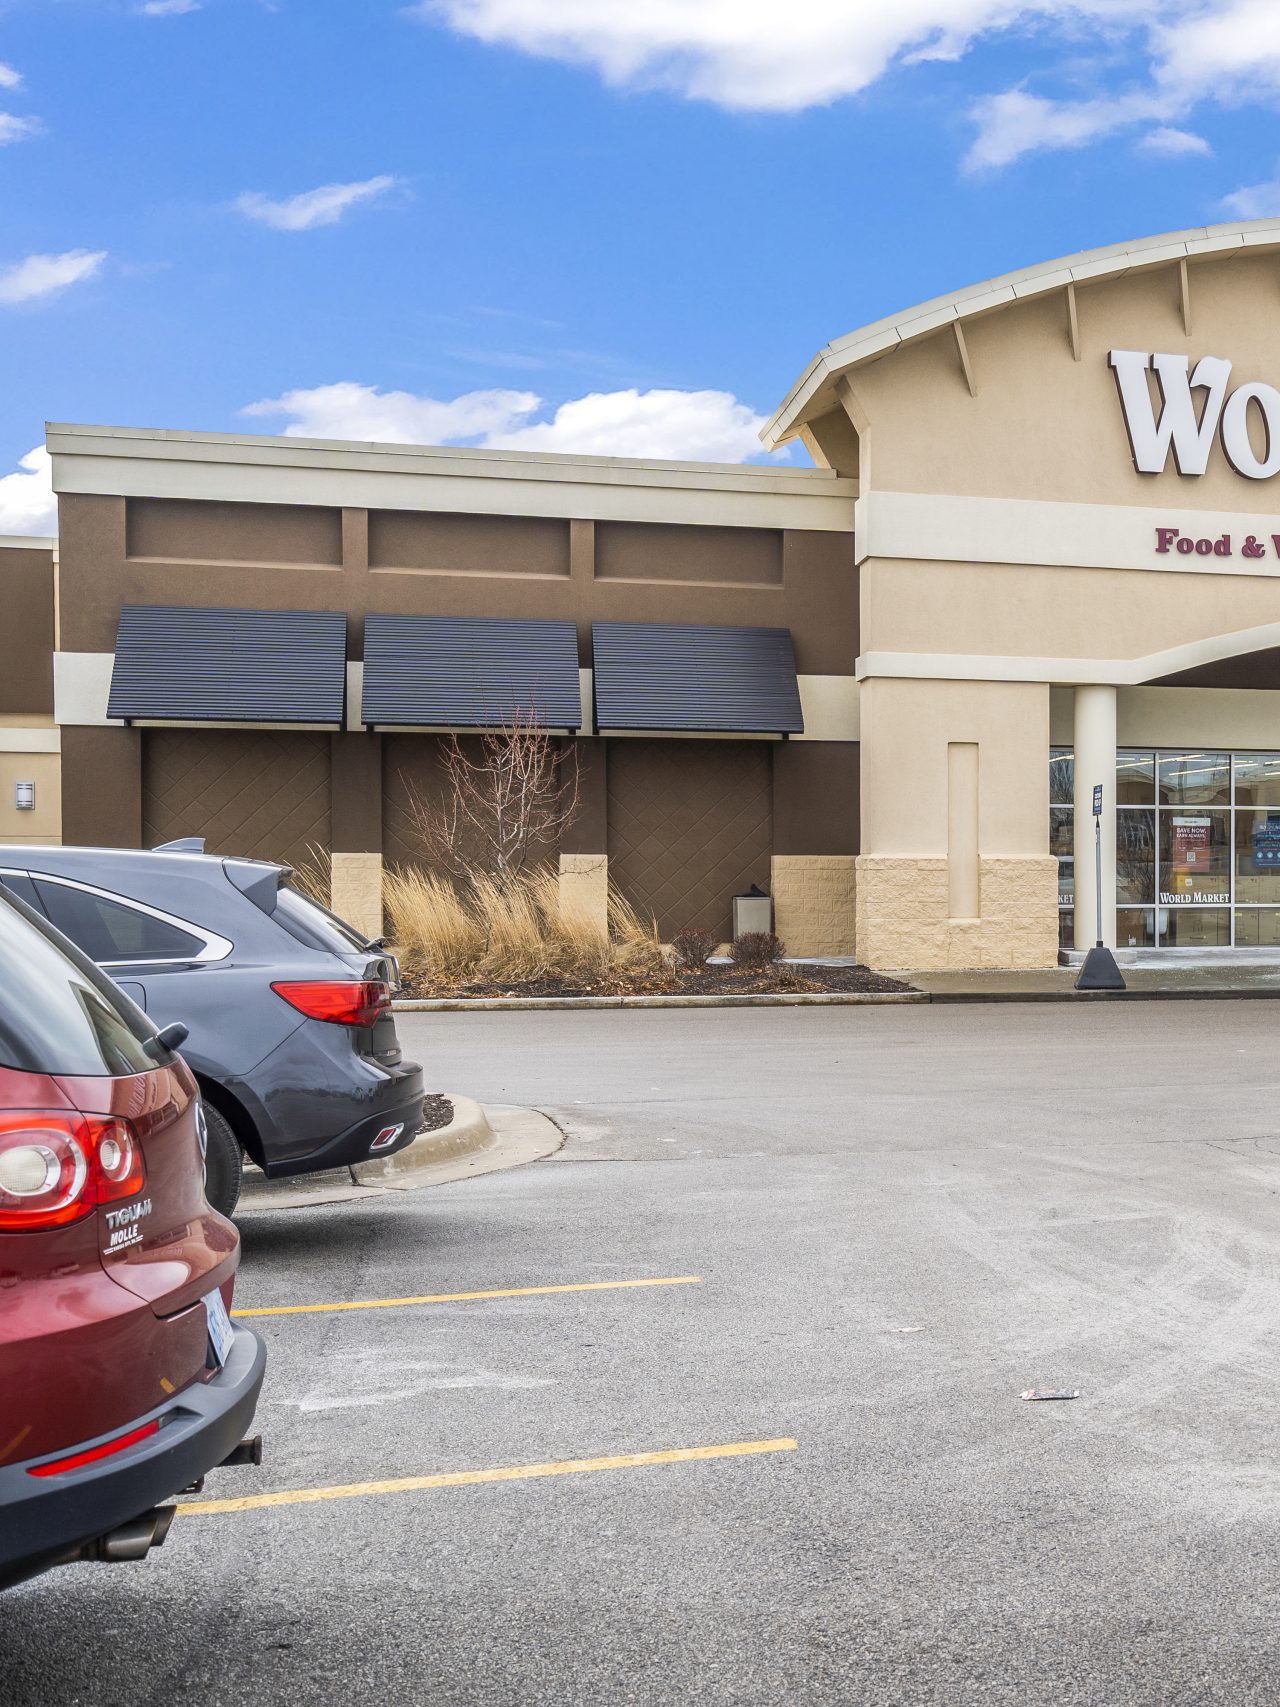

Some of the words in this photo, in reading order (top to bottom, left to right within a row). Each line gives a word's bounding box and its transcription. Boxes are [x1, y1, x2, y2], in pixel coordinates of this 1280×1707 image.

[1155, 527, 1232, 556] Food
[1241, 535, 1266, 558] &
[1058, 895, 1073, 903] KET
[1160, 892, 1191, 903] WORLD
[1193, 892, 1229, 903] MARKET
[105, 1198, 152, 1230] TIGUAN
[110, 1224, 138, 1247] MOLLE
